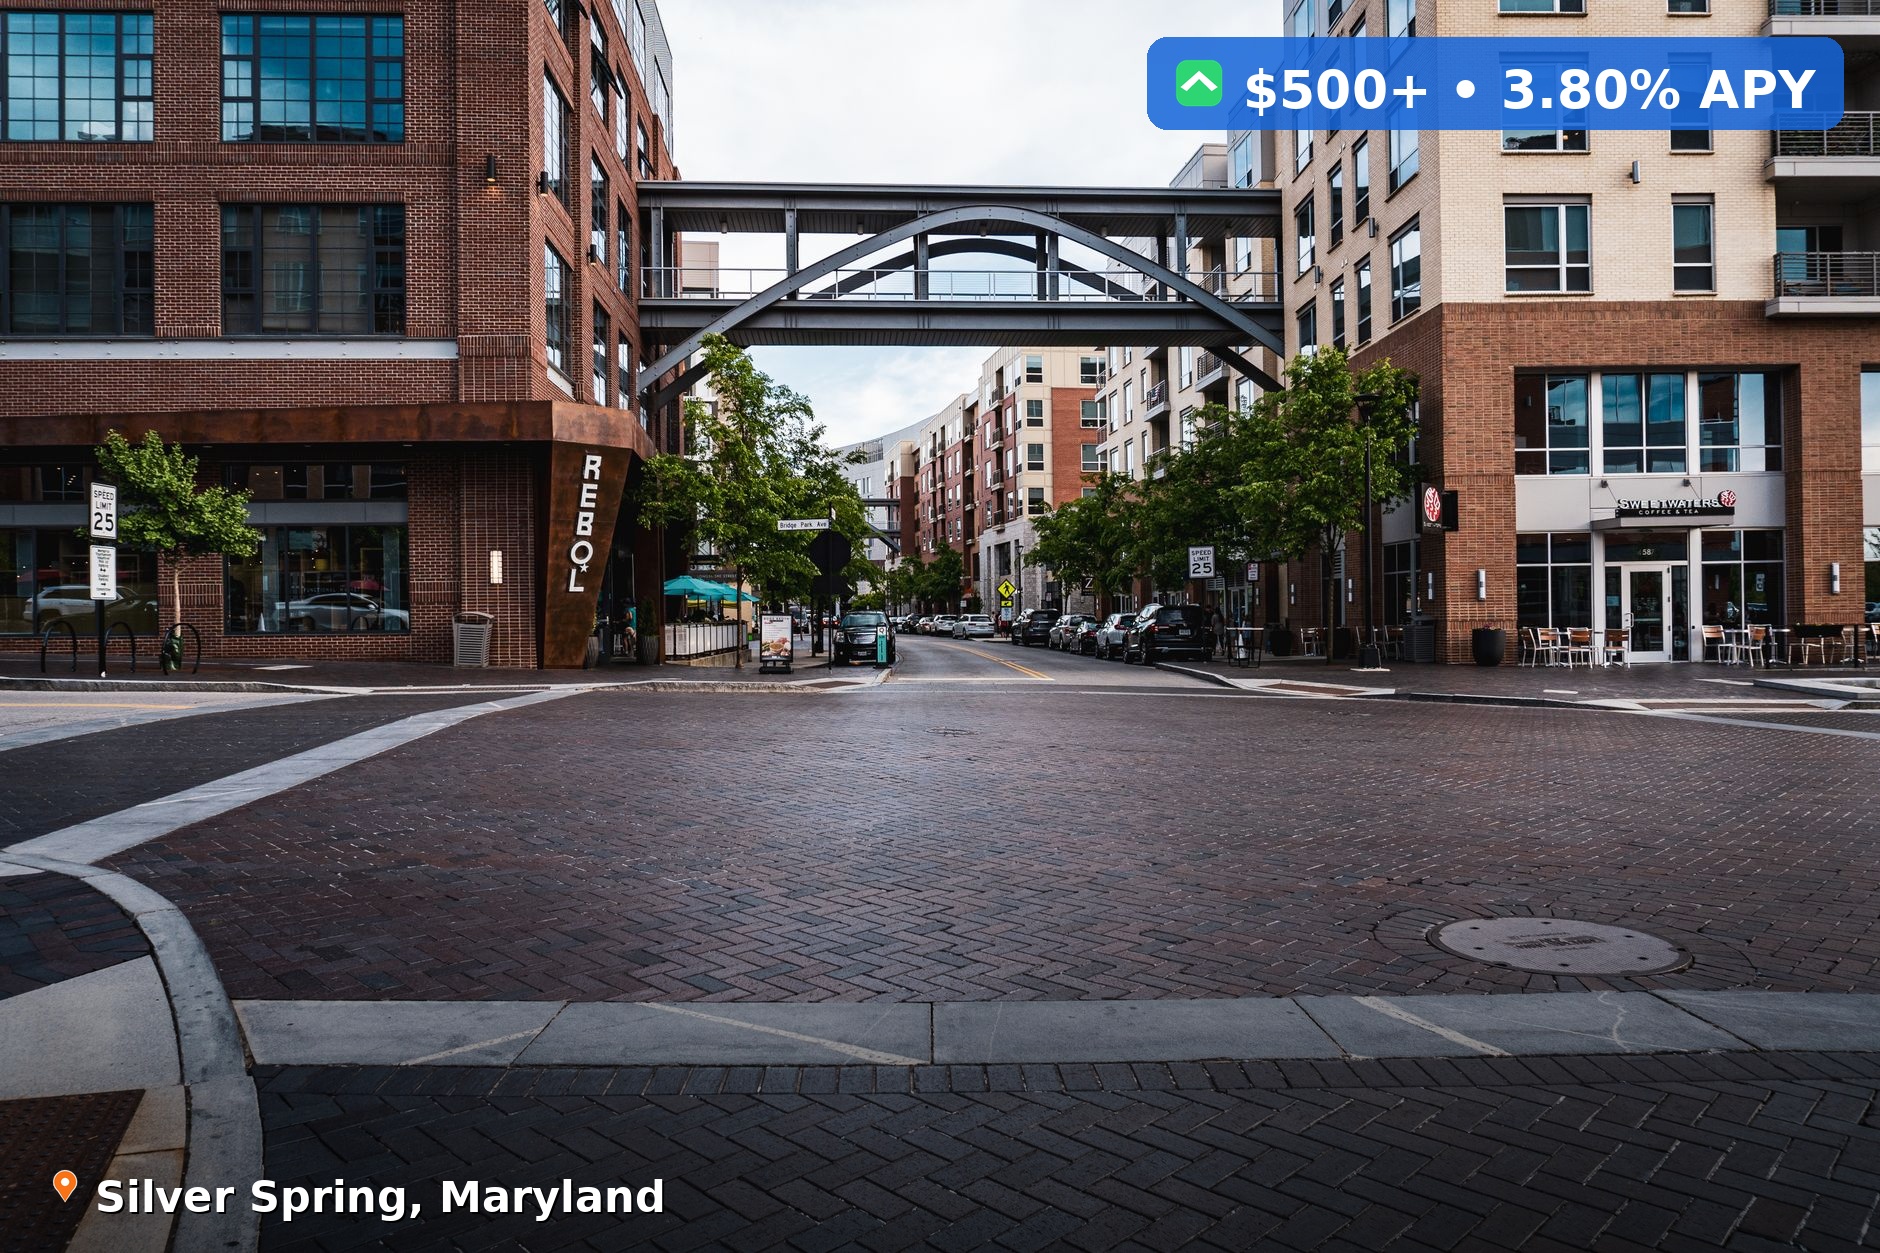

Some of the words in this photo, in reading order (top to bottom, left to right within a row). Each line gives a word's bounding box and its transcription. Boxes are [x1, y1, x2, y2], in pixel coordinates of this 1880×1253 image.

[94, 490, 114, 500] SPEED
[96, 501, 112, 510] LIMIT
[1619, 499, 1723, 509] SWEETWATERS
[94, 512, 114, 531] 25
[569, 455, 602, 592] REBOL
[1192, 563, 1212, 574] 25
